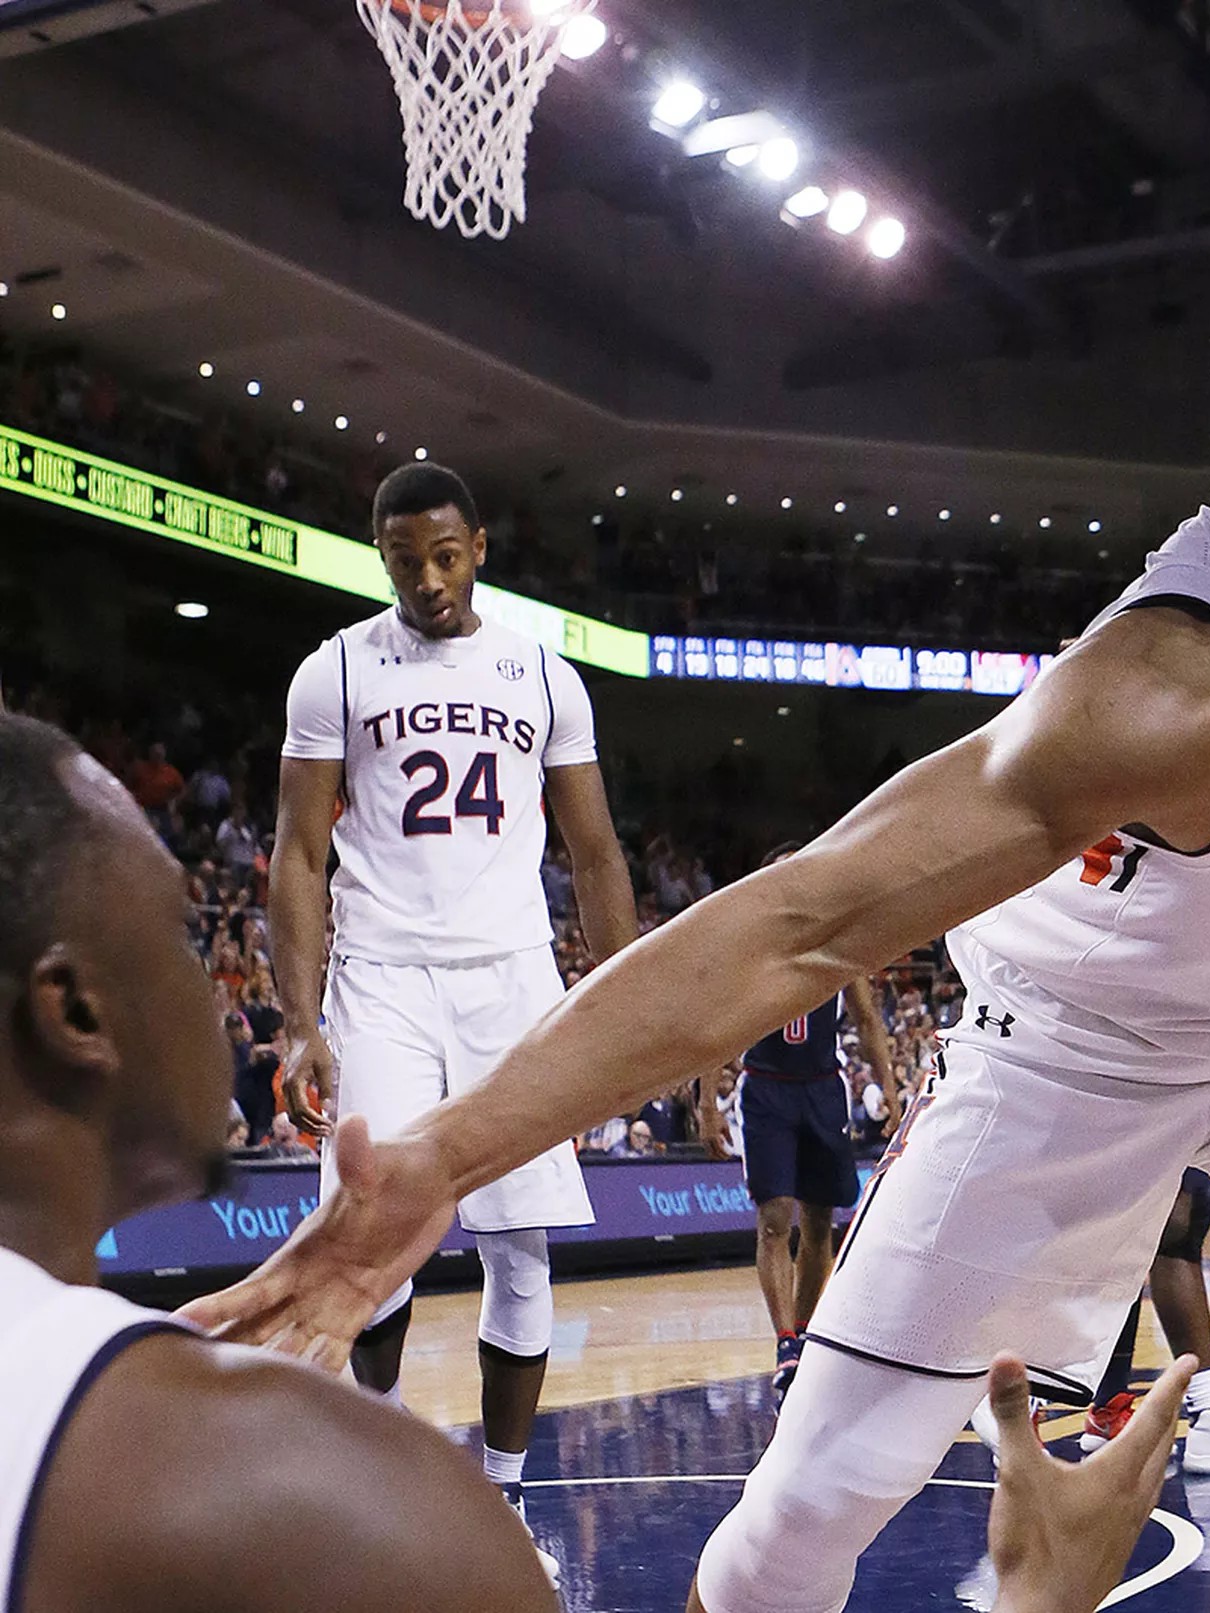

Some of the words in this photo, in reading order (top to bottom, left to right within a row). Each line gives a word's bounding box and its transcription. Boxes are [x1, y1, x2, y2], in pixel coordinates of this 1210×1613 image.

[498, 660, 524, 681] SEC
[363, 702, 536, 754] TIGERS
[400, 750, 505, 837] 24
[210, 1199, 290, 1240] Your
[640, 1184, 690, 1216] Your
